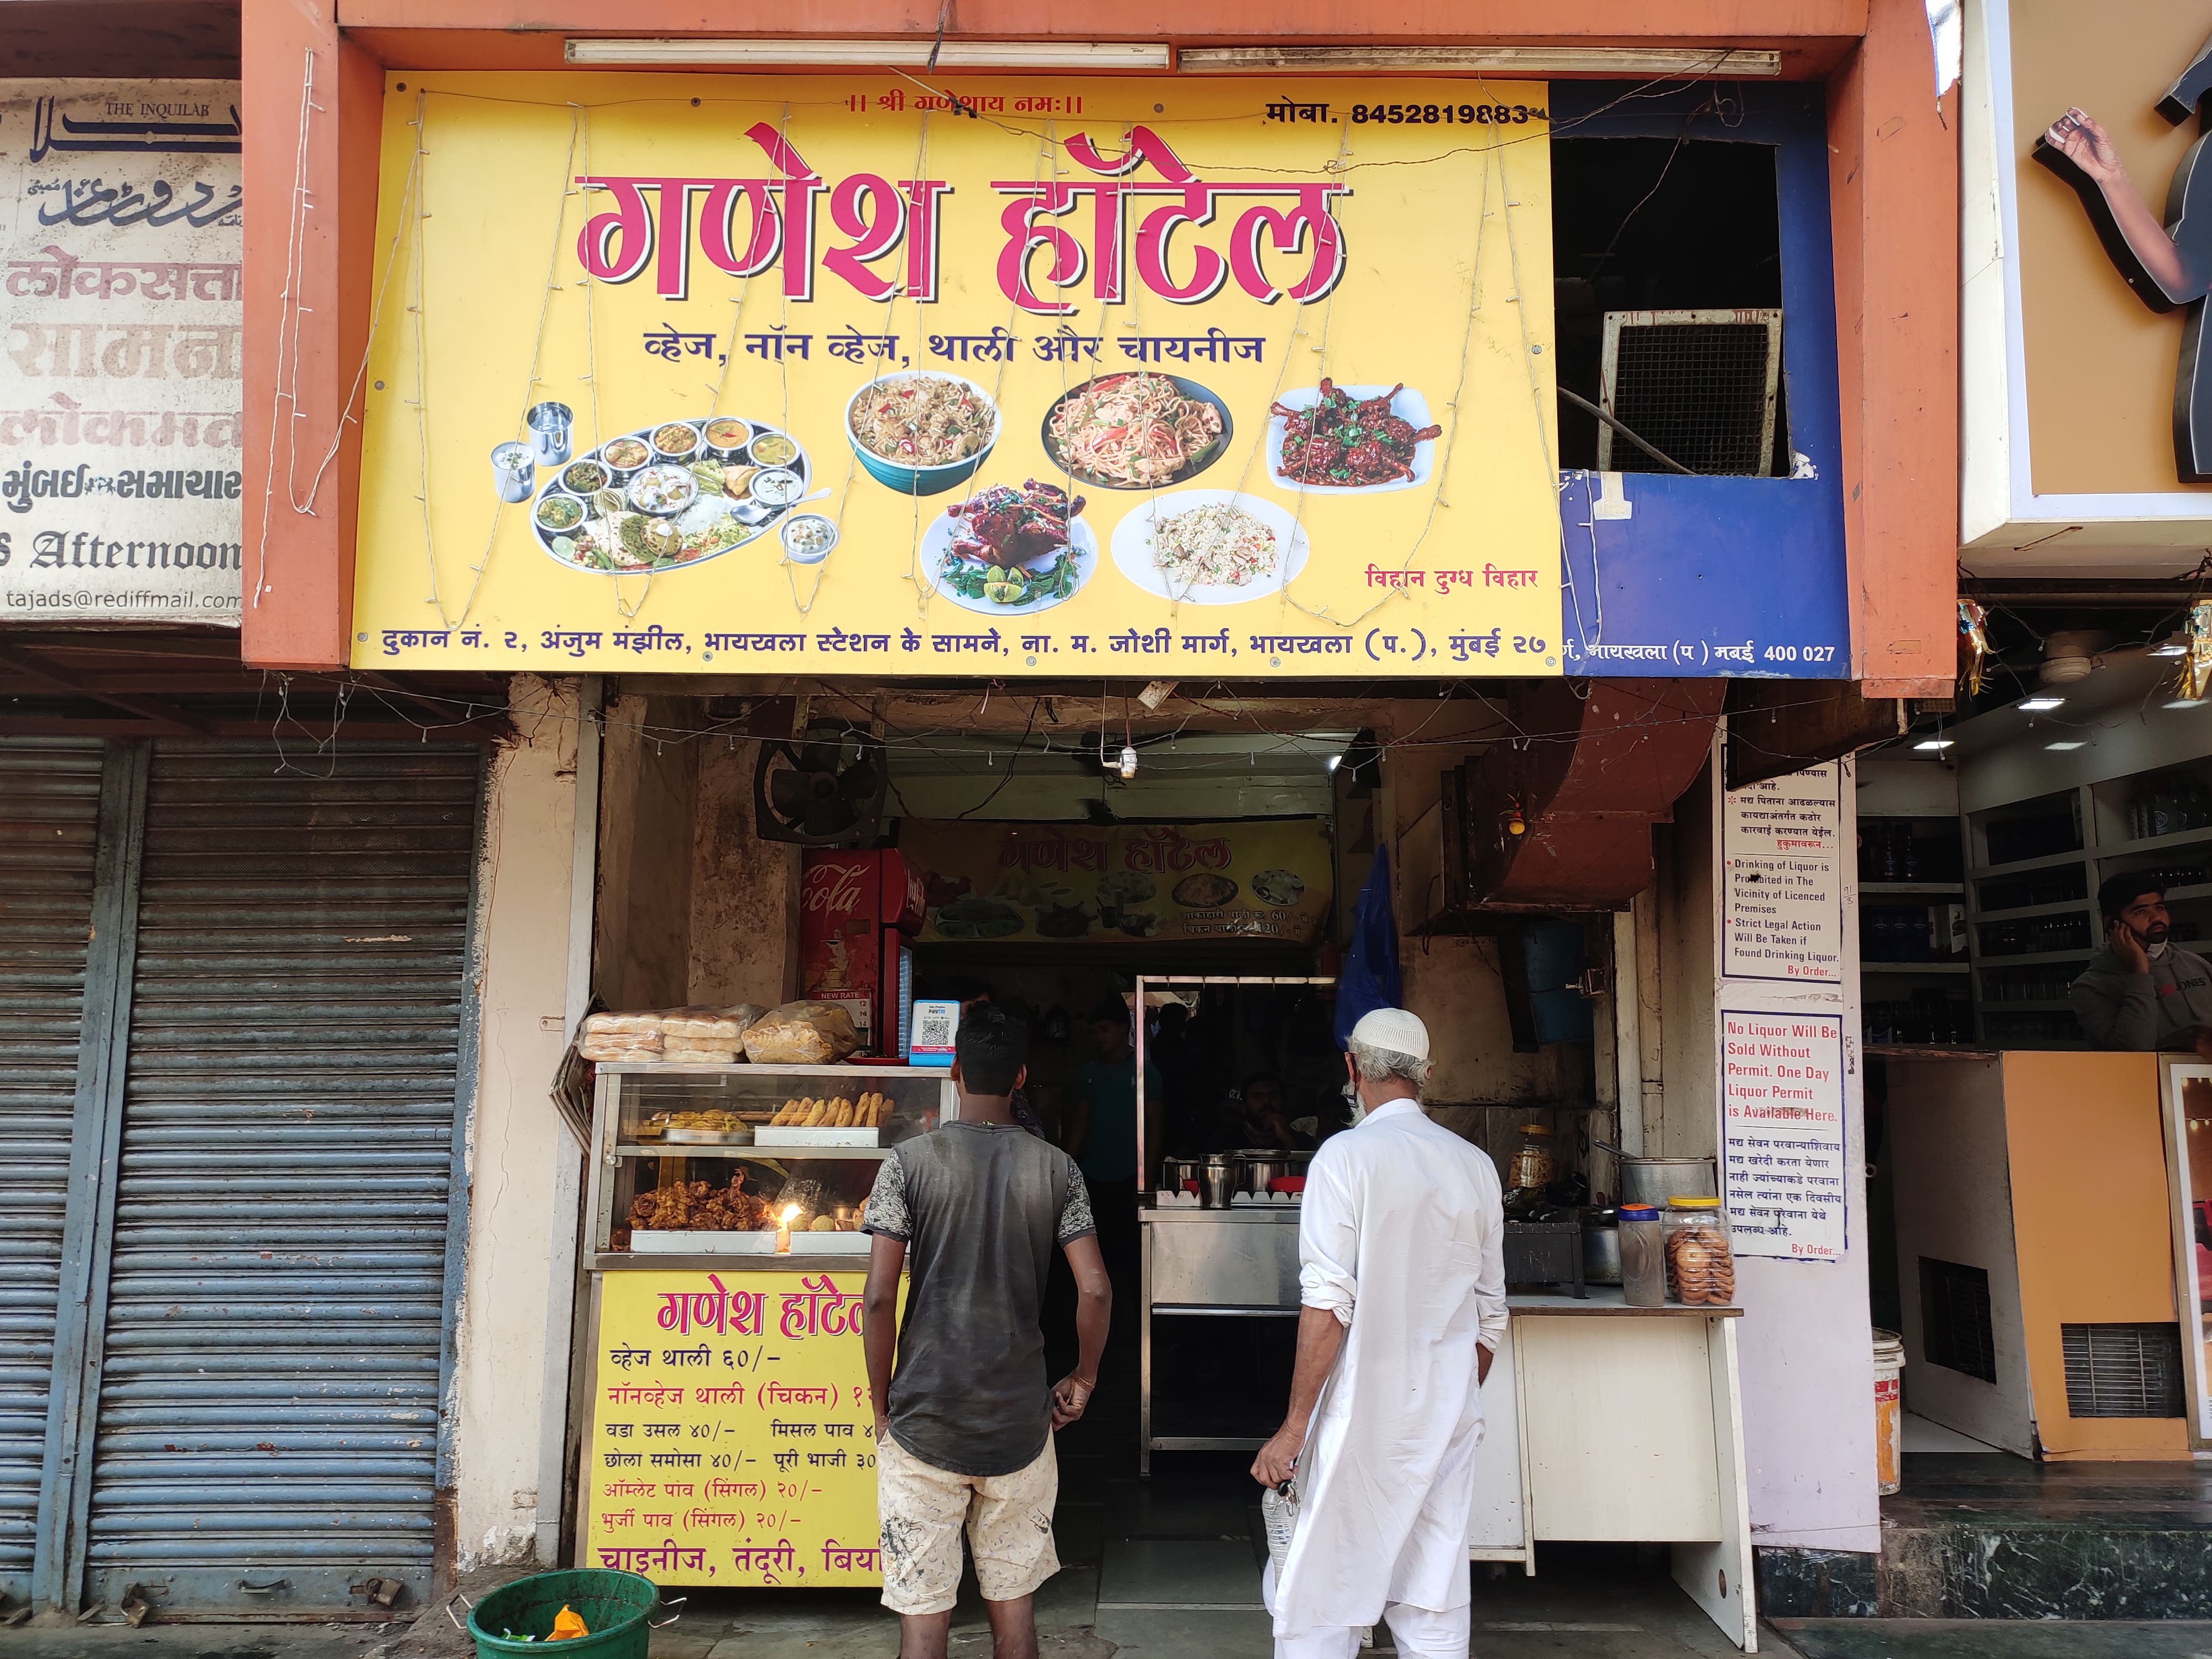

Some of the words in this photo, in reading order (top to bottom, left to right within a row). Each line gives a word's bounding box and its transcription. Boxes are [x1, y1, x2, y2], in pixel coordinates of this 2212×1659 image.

[106, 103, 133, 115] THE
[140, 103, 209, 117] INQUILAB
[877, 89, 906, 112] श्री
[1266, 95, 1338, 123] मोबा.
[1352, 104, 1529, 124] 8452819883
[575, 122, 955, 304] गणेश
[990, 125, 1354, 316] हॉटेल
[8, 323, 242, 379] सामन
[643, 322, 727, 367] व्हेज,
[744, 325, 813, 362] नॉन
[826, 325, 910, 369] व्हेज,
[929, 326, 1018, 363] थाली
[1032, 325, 1104, 363] और
[1117, 327, 1266, 364] चायनीज
[2, 461, 91, 513] મુંબઈ
[116, 469, 242, 499] સમાચાર
[29, 530, 242, 570] Afternoon
[1364, 564, 1426, 588] विहान
[1434, 570, 1474, 594] दुग्ध
[1481, 563, 1538, 590] विहार
[6, 590, 242, 609] tajads@rediffmail.com
[382, 630, 451, 655] दुकान
[461, 624, 489, 649] नं.
[504, 632, 527, 653] २,
[541, 624, 603, 657] अंजुम
[613, 624, 692, 655] मंझील,
[705, 633, 806, 651] भायखला
[816, 627, 891, 653] स्टेशन
[901, 627, 922, 653] के
[932, 628, 1009, 657] सामने,
[1021, 635, 1058, 654] ना.
[1071, 635, 1097, 654] म.
[1109, 628, 1172, 654] जोशी
[1182, 628, 1238, 658] मार्ग,
[1250, 635, 1353, 654] भायखला
[1448, 628, 1501, 660] मुंबई
[1513, 635, 1546, 653] २७
[1764, 645, 1797, 662] 400
[1802, 646, 1835, 662] 027
[1757, 794, 1785, 806] पिताना
[1799, 811, 1822, 822] कठोर
[1740, 824, 1772, 837] कारवाई
[1774, 827, 1809, 836] करण्यात
[999, 831, 1112, 875] गणेश
[1121, 828, 1233, 873] हॉटेल
[1735, 859, 1774, 872] Drinking
[1776, 860, 1787, 871] of
[1789, 860, 1819, 873] Liquor
[1820, 862, 1830, 872] is
[1785, 875, 1793, 885] in
[1796, 875, 1814, 886] The
[1734, 888, 1770, 901] Vicinity
[1772, 889, 1782, 900] of
[1785, 890, 1825, 902] Licenced
[1734, 903, 1777, 914] Premises
[1735, 917, 1762, 929] Strict
[1765, 919, 1788, 932] Legal
[1791, 920, 1822, 932] Action
[1734, 932, 1753, 943] Will
[1756, 933, 1768, 943] Be
[1771, 934, 1797, 945] Taken
[1799, 935, 1807, 946] if
[1734, 947, 1762, 958] Found
[1765, 949, 1804, 962] Drinking
[1808, 951, 1839, 963] Liquor.
[1787, 964, 1799, 977] By
[1728, 1021, 1744, 1035] No
[1748, 1022, 1788, 1039] Liquor
[1792, 1024, 1817, 1038] Will
[1822, 1026, 1838, 1040] Be
[1728, 1042, 1756, 1057] Sold
[1759, 1044, 1811, 1059] Without
[1728, 1062, 1773, 1078] Permit.
[1777, 1065, 1802, 1078] One
[1806, 1066, 1830, 1083] Day
[1728, 1083, 1768, 1099] Liquor
[1772, 1085, 1814, 1100] Permit
[1728, 1104, 1739, 1118] is
[1744, 1105, 1802, 1121] Available
[1805, 1107, 1838, 1123] Here.
[1747, 1135, 1770, 1148] सेवन
[1747, 1153, 1773, 1167] खरेदी
[1776, 1157, 1802, 1167] करता
[1729, 1170, 1749, 1183] नाही
[1806, 1176, 1840, 1186] परवाना
[1729, 1186, 1754, 1199] नसेल
[1786, 1193, 1802, 1203] एक
[1792, 1243, 1804, 1256] By
[656, 1273, 769, 1337] गणेश
[609, 1342, 652, 1371] व्हेज
[662, 1343, 712, 1367] थाली
[607, 1380, 685, 1408] नॉनव्हेज
[695, 1381, 746, 1405] थाली
[757, 1381, 839, 1411] (चिकन)
[605, 1423, 635, 1438] वडा
[643, 1423, 681, 1438] उसल
[770, 1419, 817, 1438] मिसल
[823, 1423, 855, 1438] पाव
[603, 1448, 643, 1468] छोला
[649, 1448, 702, 1468] समोसा
[773, 1448, 800, 1473] पूरी
[807, 1448, 847, 1467] भाजी
[602, 1478, 657, 1499] ऑम्लेट
[704, 1478, 767, 1503] (सिंगल)
[642, 1513, 673, 1528] पाव
[683, 1507, 746, 1532] (सिंगल)
[597, 1538, 717, 1578] चाइनीज,
[732, 1537, 805, 1584] तंदूरी,
